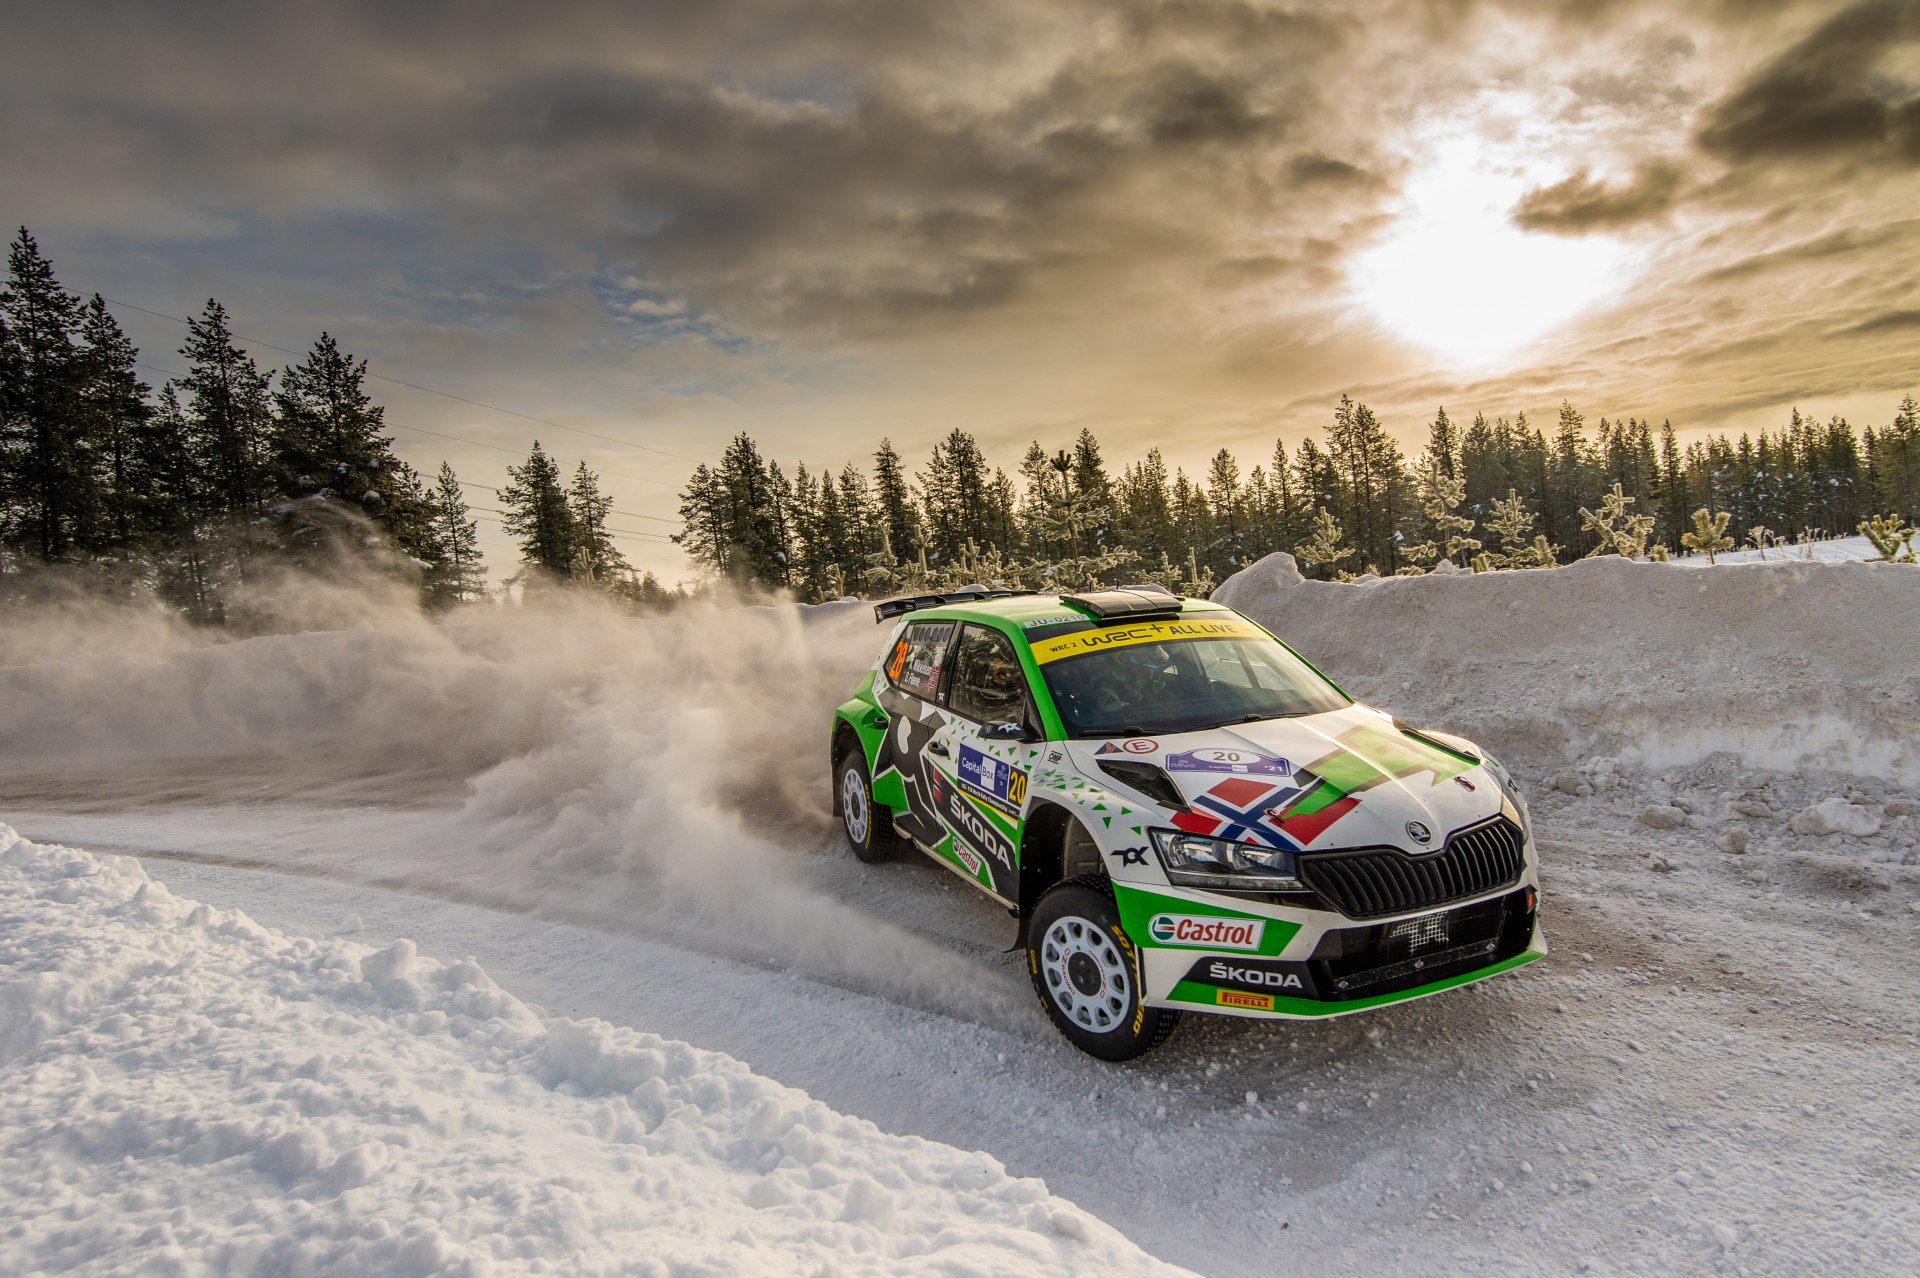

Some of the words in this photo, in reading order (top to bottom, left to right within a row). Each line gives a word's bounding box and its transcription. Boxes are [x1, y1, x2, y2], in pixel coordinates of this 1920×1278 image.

[1049, 643, 1070, 653] WRC
[1169, 625, 1201, 635] ALL
[1202, 624, 1238, 633] LIVE
[1048, 752, 1062, 762] OMP
[1213, 751, 1241, 762] 20
[1008, 771, 1026, 805] 20
[950, 792, 1012, 872] ŠKODA
[958, 844, 979, 874] Castrol
[1176, 919, 1254, 945] Castrol
[1209, 961, 1303, 989] ŠKODA
[1222, 991, 1270, 1008] PIRELLI
